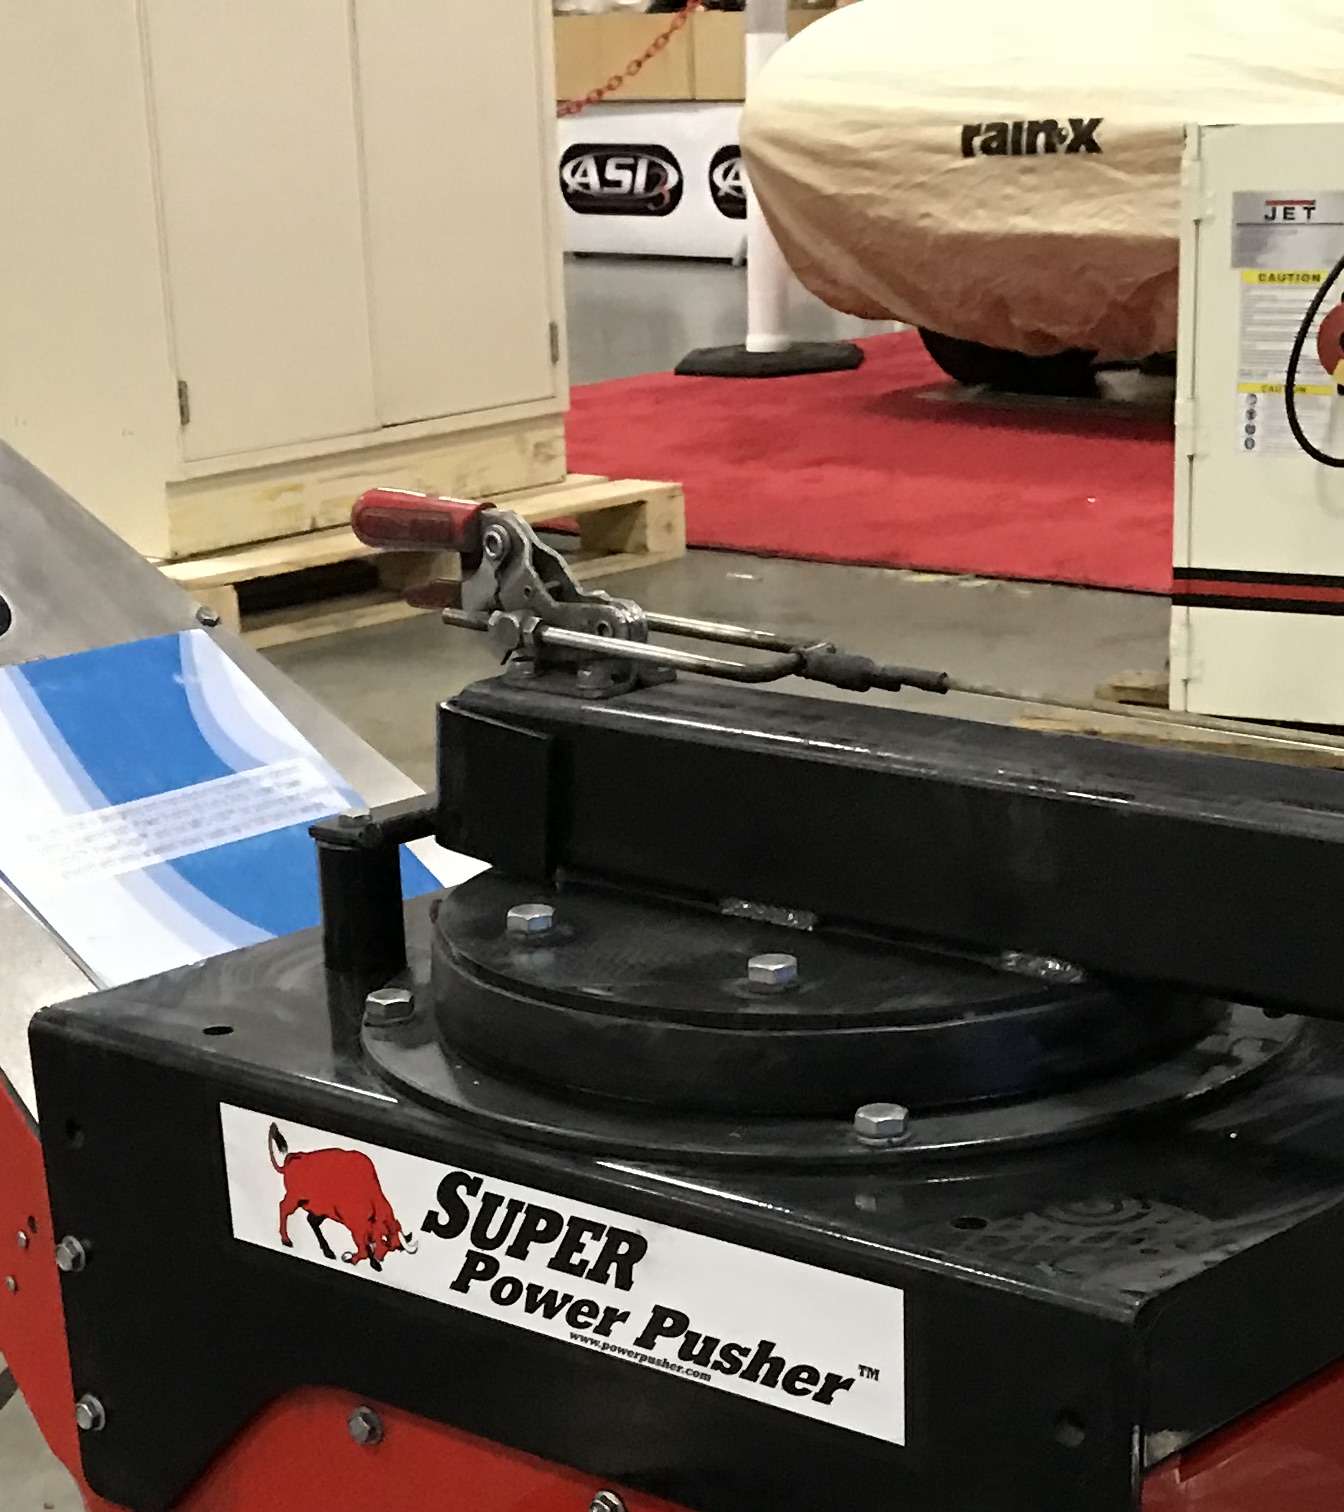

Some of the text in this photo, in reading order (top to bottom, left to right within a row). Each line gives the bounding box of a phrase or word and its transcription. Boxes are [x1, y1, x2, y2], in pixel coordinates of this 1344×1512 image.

[1264, 206, 1317, 221] JET
[1258, 273, 1321, 283] CAUTION
[420, 1170, 648, 1291] SUPER
[449, 1250, 631, 1338] Power
[633, 1303, 856, 1406] Pusher
[569, 1331, 712, 1382] www.powerpusher.com
